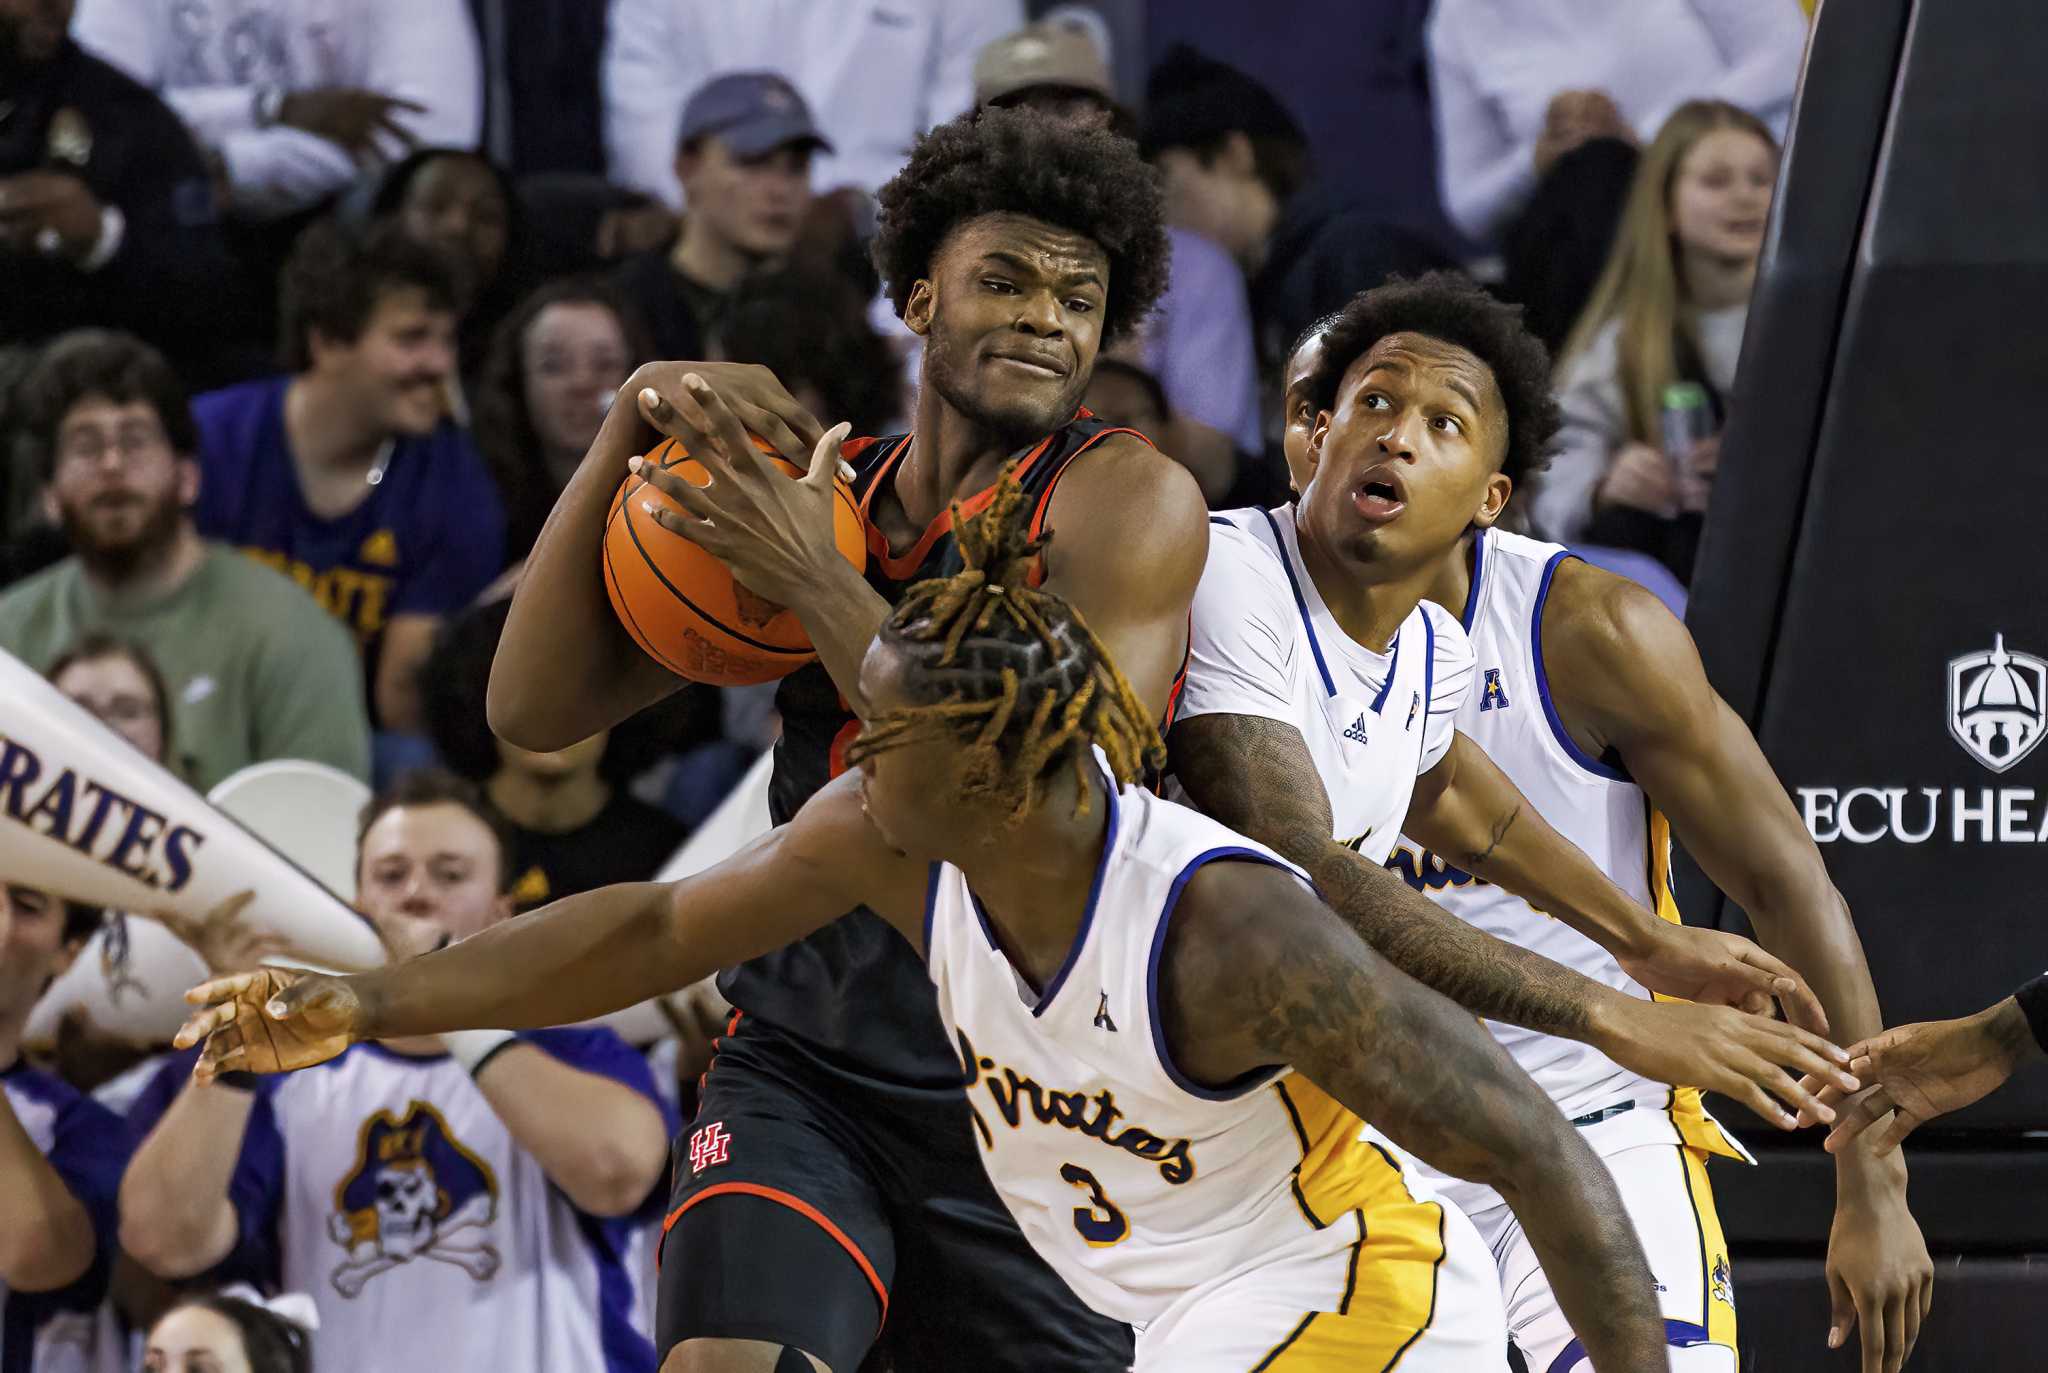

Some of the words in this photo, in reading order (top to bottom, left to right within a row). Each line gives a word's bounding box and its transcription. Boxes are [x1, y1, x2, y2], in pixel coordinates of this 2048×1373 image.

[0, 734, 206, 893] RATES
[1796, 786, 1943, 844] ECU
[1952, 788, 2048, 843] HE
[1059, 1162, 1132, 1248] 3
